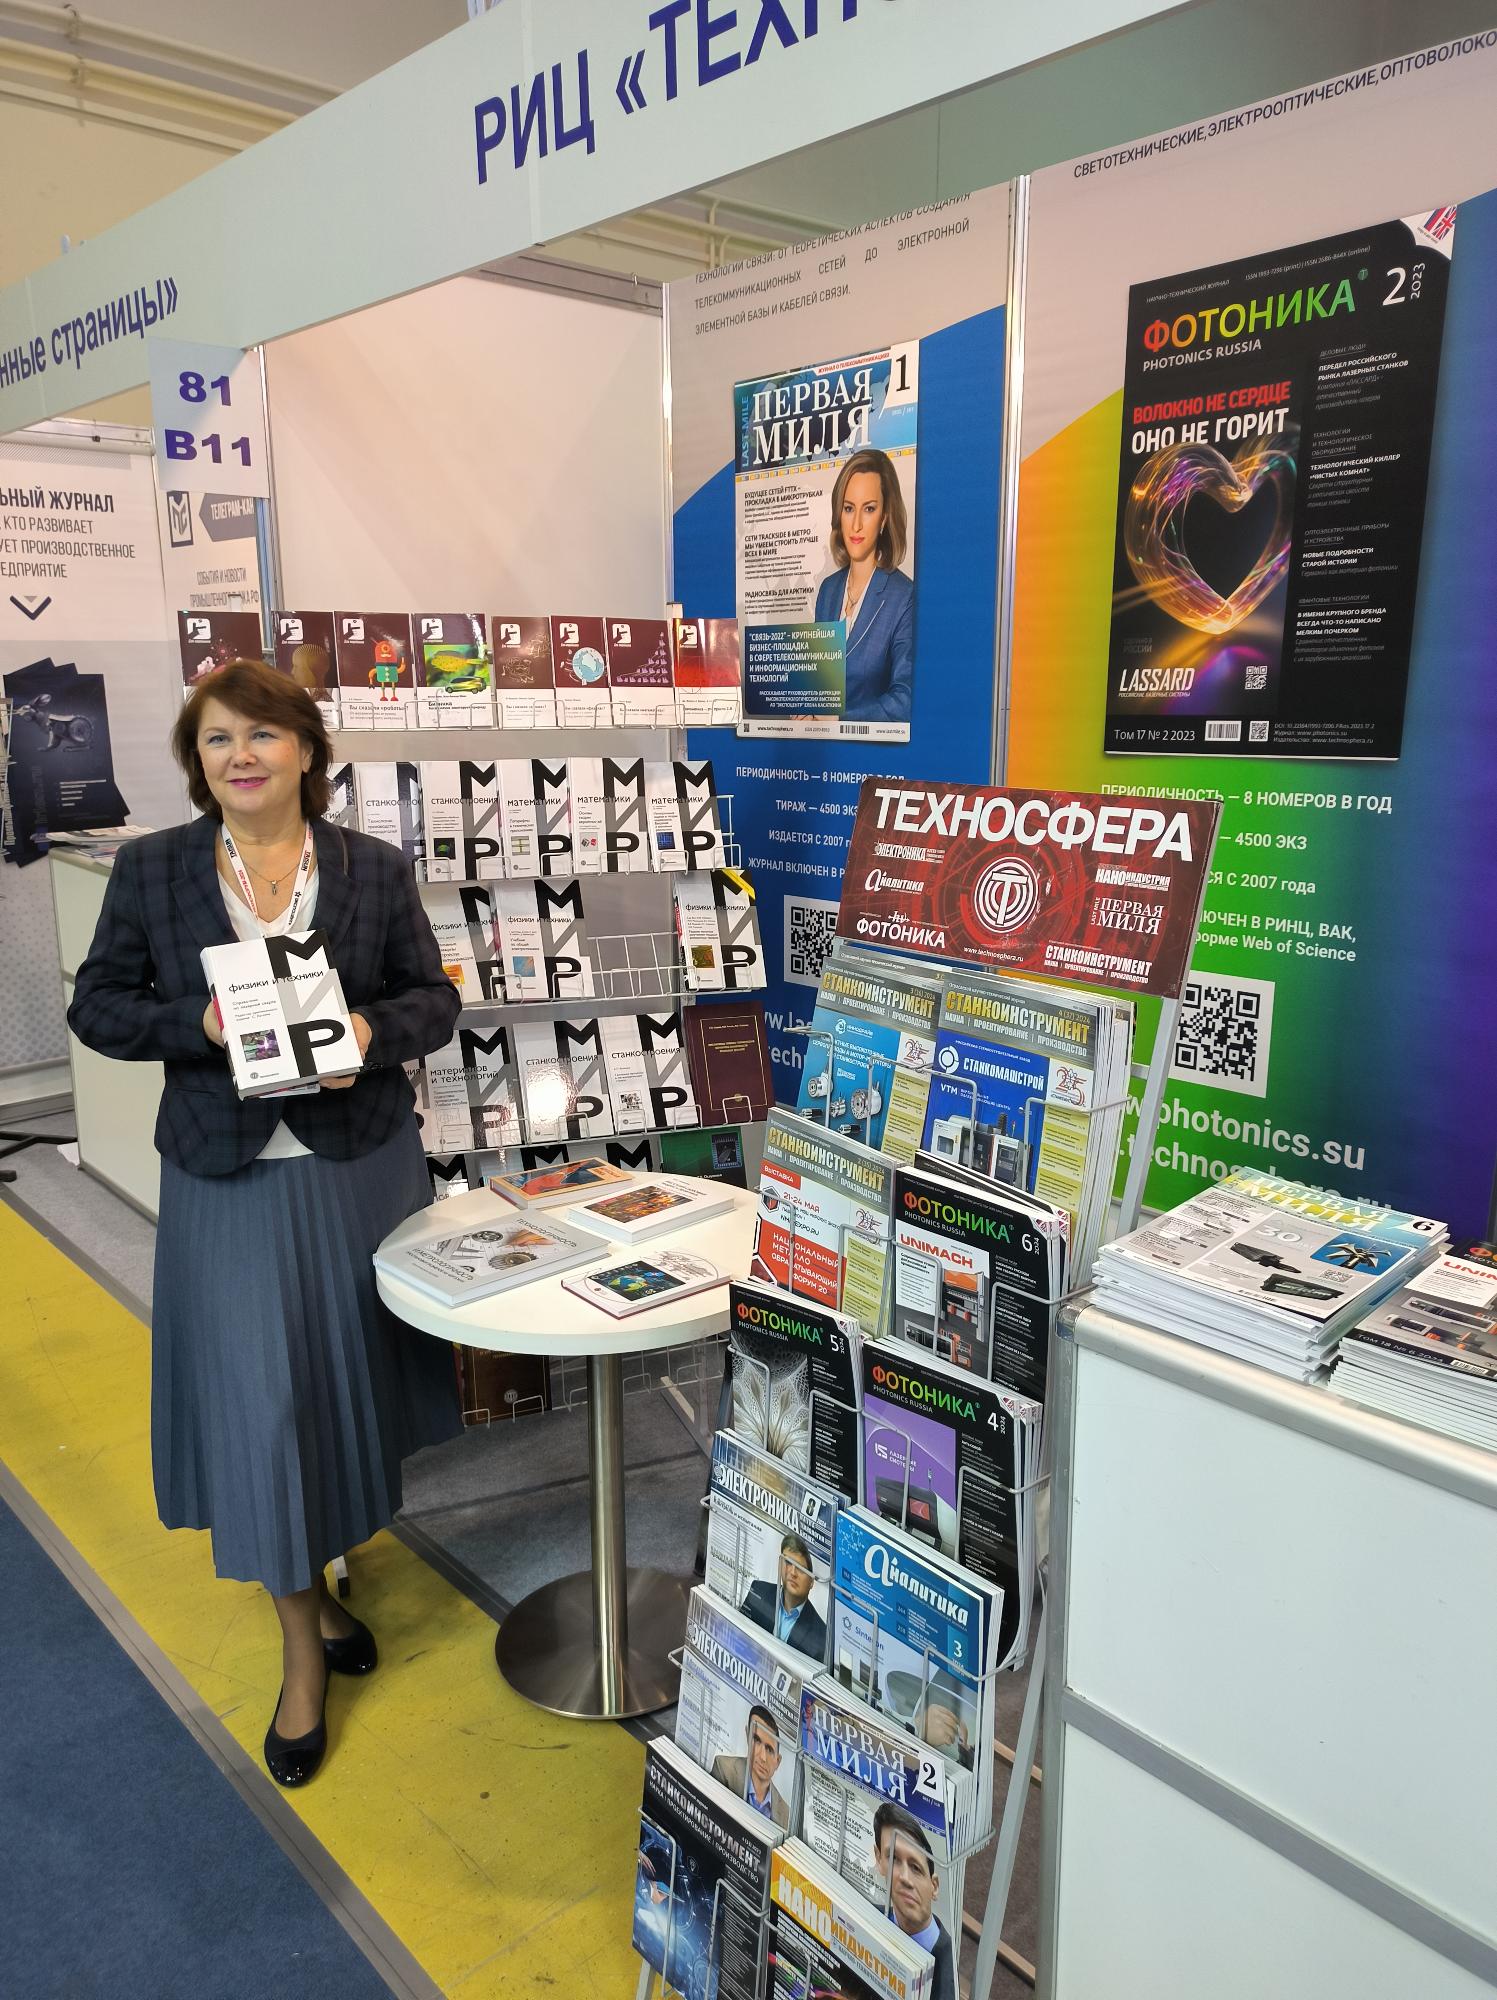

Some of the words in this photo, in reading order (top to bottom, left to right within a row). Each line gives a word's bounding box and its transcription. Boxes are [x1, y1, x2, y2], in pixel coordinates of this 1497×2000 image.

[475, 49, 595, 185] РИЦ
[696, 271, 801, 310] ТЕЛЕКОММУНИКАЦИОННЫХ
[818, 256, 846, 275] СЕТЕЙ
[865, 247, 877, 264] ДО
[898, 218, 970, 251] ЭЛЕКТРОННОЙ
[696, 311, 746, 336] ЭЛЕМЕНТНОЙ
[748, 305, 770, 322] БАЗЫ
[771, 305, 778, 316] И
[779, 290, 817, 313] КАБЕЛЕЙ
[819, 284, 851, 302] СВЯЗИ.
[1143, 278, 1357, 353] ФОТОНИКА
[1383, 266, 1407, 306] 2
[1410, 261, 1425, 301] 2023
[52, 277, 178, 369] страницы»
[1143, 348, 1212, 373] PHOTONICS
[1216, 338, 1262, 358] RUSSIA
[1347, 352, 1398, 367] РОССИЙСКОГО
[179, 371, 231, 406] 81
[752, 368, 873, 424] ПЕРВАЯ
[896, 354, 910, 393] 1
[1133, 396, 1203, 425] ВОЛОКНО
[1206, 392, 1227, 413] НЕ
[1228, 381, 1292, 408] СЕРДЦЕ
[752, 404, 872, 466] МИЛЯ
[1132, 425, 1175, 455] ОНО
[1181, 420, 1209, 445] НЕ
[1215, 407, 1290, 443] ГОРИТ
[49, 490, 115, 513] ЖУРНАЛ
[3, 515, 26, 532] КТО
[29, 516, 93, 535] РАЗВИВАЕТ
[20, 539, 136, 559] ПРОИЗВОДСТВЕННОЕ
[750, 642, 809, 652] БИЗНЕС-ПЛОЩАДКА
[1118, 667, 1195, 693] LASSARD
[1113, 729, 1133, 741] Том
[1135, 729, 1146, 741] 17
[1161, 730, 1168, 741] 2
[1169, 729, 1195, 741] 2023
[736, 766, 809, 781] ПЕРИОДИЧНОСТЬ
[822, 771, 828, 782] 8
[507, 797, 561, 807] математики
[577, 796, 631, 805] математики
[651, 796, 704, 806] математики
[776, 799, 806, 812] ТИРАЖ
[820, 803, 841, 815] 4500
[1243, 790, 1253, 806] 8
[1256, 791, 1337, 810] НОМЕРОВ
[1340, 794, 1353, 811] В
[1356, 795, 1393, 815] ГОД
[768, 829, 813, 844] ИЗДАЕТСЯ
[815, 833, 821, 844] С
[823, 835, 844, 847] 2007
[875, 788, 1193, 863] ТЕХНОСФЕРА
[1235, 832, 1272, 848] 4500
[1275, 834, 1308, 850] ЭКЗ
[748, 857, 784, 872] ЖУРНАЛ
[785, 861, 828, 877] ВКЛЮЧЕН
[831, 866, 837, 879] В
[1226, 872, 1238, 886] С
[1240, 873, 1278, 891] 2007
[1280, 879, 1316, 896] года
[1100, 897, 1164, 919] ПЕРВАЯ
[857, 918, 946, 949] ФОТОНИКА
[1096, 911, 1162, 935] МИЛЯ
[1250, 915, 1262, 929] В
[1264, 917, 1314, 939] РИНЦ,
[1318, 922, 1357, 944] ВАК,
[1045, 944, 1152, 977] СТАНКОИНСТРУМЕНТ
[1241, 934, 1274, 953] Web
[1276, 938, 1293, 955] of
[1294, 942, 1357, 962] Science
[229, 979, 268, 995] физики
[272, 976, 279, 985] и
[279, 970, 324, 984] техники
[822, 971, 936, 1019] СТАНКОИНСТРУМЕНТ
[264, 929, 349, 1078] МИР
[945, 990, 1091, 1046] СТАНКОИНСТРУМЕНТ
[611, 1046, 682, 1060] станкостроения
[1037, 1034, 1087, 1058] ПРОИЗВОДСТВО
[430, 1065, 488, 1078] материалов
[963, 1057, 1045, 1092] СТАНКОМАШСТРОЙ
[940, 1083, 958, 1097] VTM
[768, 1126, 885, 1193] СТАНКОИНСТРУМЕНТ
[764, 1164, 794, 1184] ВЫСТАВКА
[783, 1191, 803, 1206] 21-24
[803, 1200, 820, 1214] МАЯ
[904, 1190, 1011, 1244] ФОТОНИКА
[1021, 1233, 1033, 1252] 6
[904, 1210, 941, 1229] PHOTONICS
[942, 1223, 967, 1238] RUSSIA
[1412, 1220, 1436, 1231] 6
[900, 1233, 973, 1269] UNIMACH
[737, 1302, 823, 1346] ФОТОНИКА
[830, 1334, 840, 1353] 5
[739, 1321, 769, 1336] PHOTONICS
[770, 1330, 789, 1342] RUSSIA
[872, 1366, 977, 1423] ФОТОНИКА
[987, 1412, 999, 1432] 4
[873, 1384, 909, 1405] PHOTONICS
[909, 1397, 934, 1414] RUSSIA
[717, 1464, 800, 1536] ЭЛЕКТРОНИКА
[953, 1640, 963, 1658] 3
[692, 1623, 769, 1707] ЭЛЕКТРОНИКА
[813, 1703, 906, 1776] ПЕРВАЯ
[922, 1763, 937, 1791] 2
[814, 1726, 909, 1807] МИЛЯ
[650, 1764, 761, 1873] СТАНКОИНСТРУМЕНТ
[716, 1842, 759, 1884] ПРОИЗВОДСТВО
